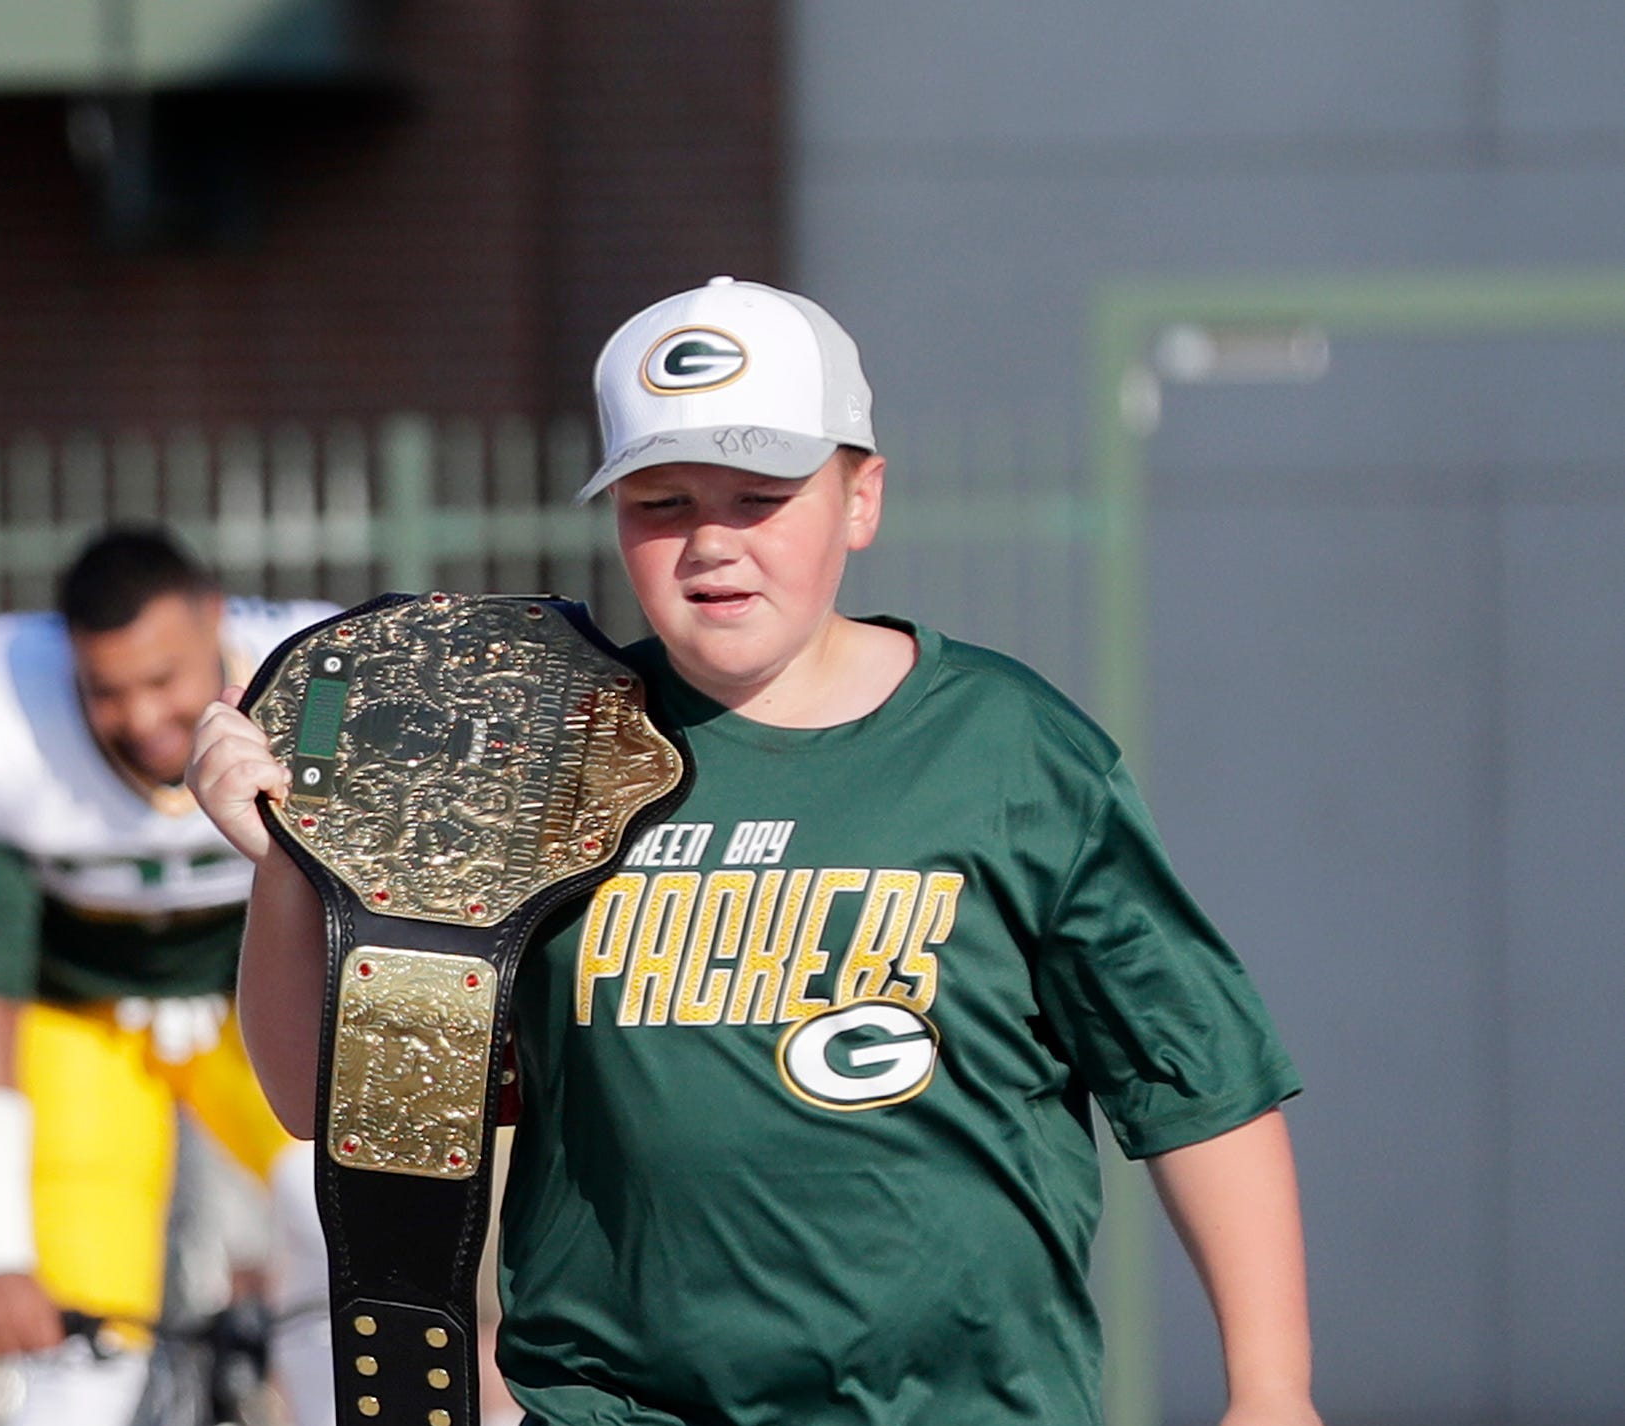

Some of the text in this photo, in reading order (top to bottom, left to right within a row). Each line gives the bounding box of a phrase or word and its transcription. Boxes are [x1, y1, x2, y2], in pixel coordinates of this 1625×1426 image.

[642, 328, 746, 391] G
[722, 820, 796, 865] BAY
[574, 867, 966, 1028] PACKERS
[782, 1000, 938, 1107] G
